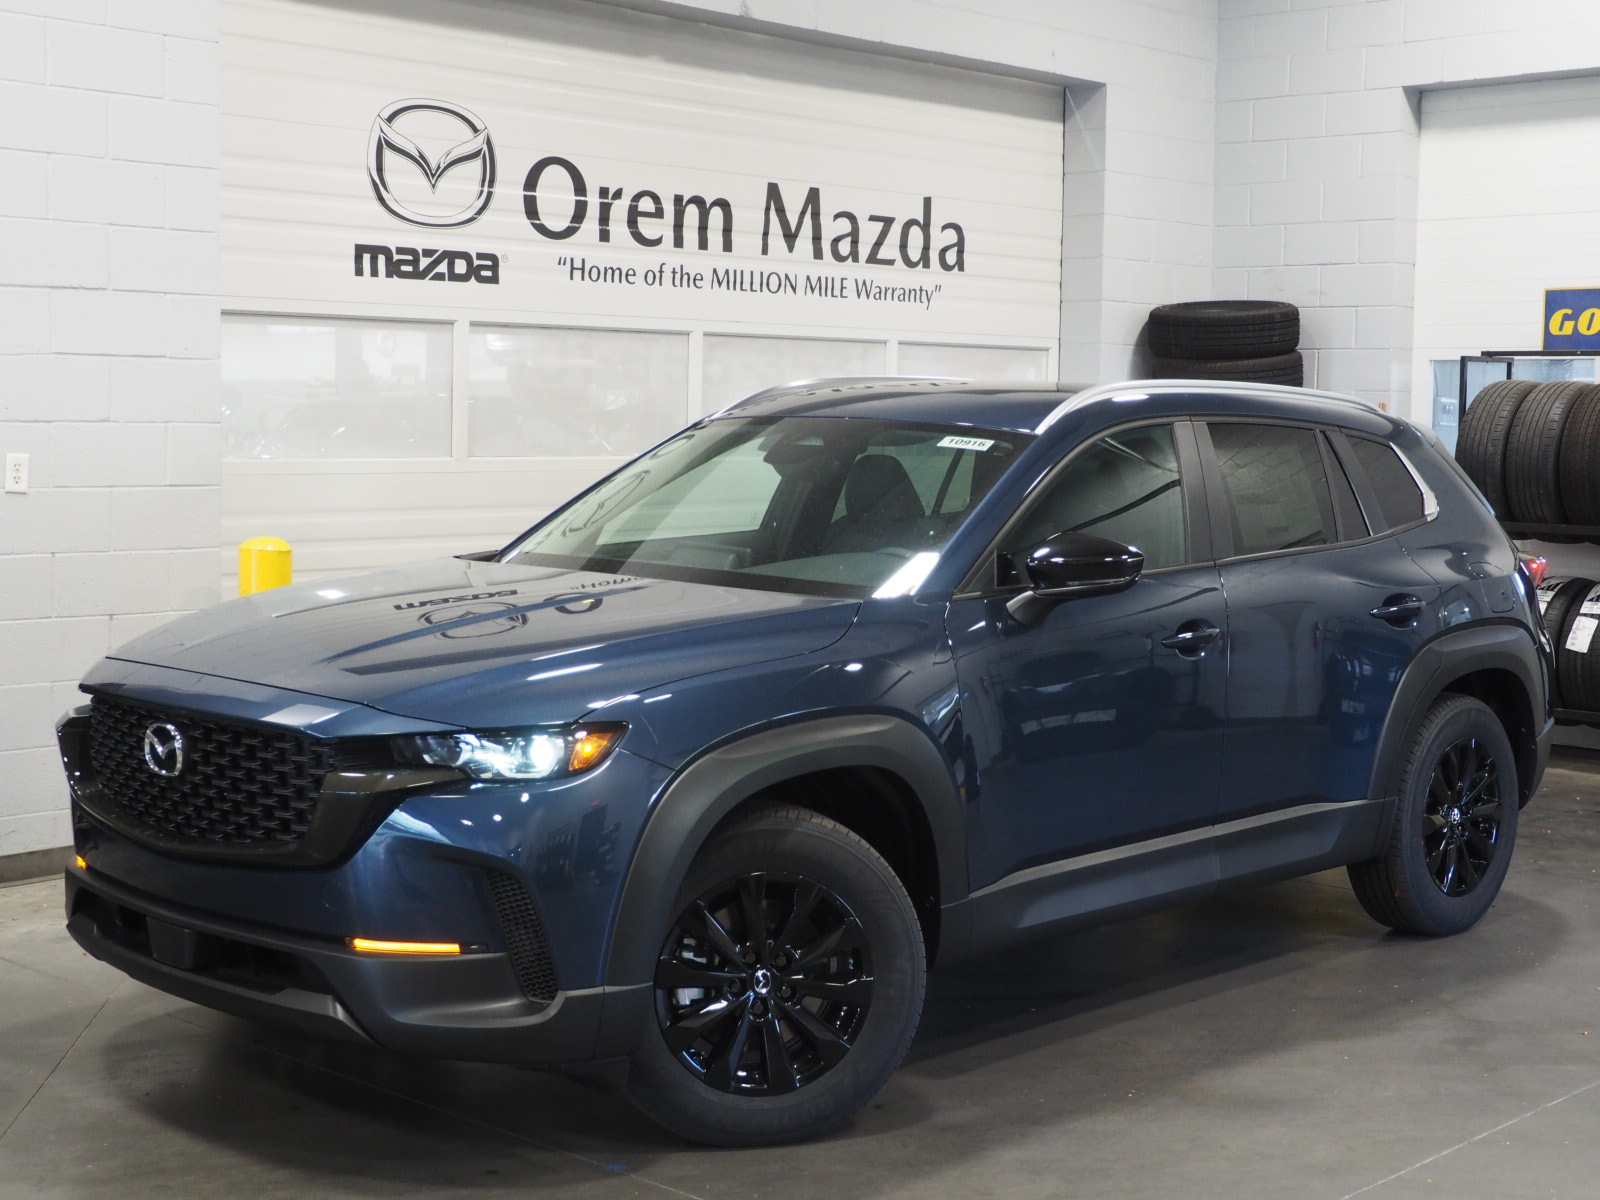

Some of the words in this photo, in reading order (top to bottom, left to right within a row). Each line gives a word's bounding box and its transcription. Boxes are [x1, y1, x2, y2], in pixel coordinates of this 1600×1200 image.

[522, 156, 733, 253] Orem
[761, 181, 966, 273] Mazda
[557, 256, 637, 285] “Home
[643, 262, 667, 287] of
[671, 264, 704, 290] the
[710, 267, 798, 297] MILLION
[804, 274, 849, 299] MILE
[949, 438, 988, 447] 10916
